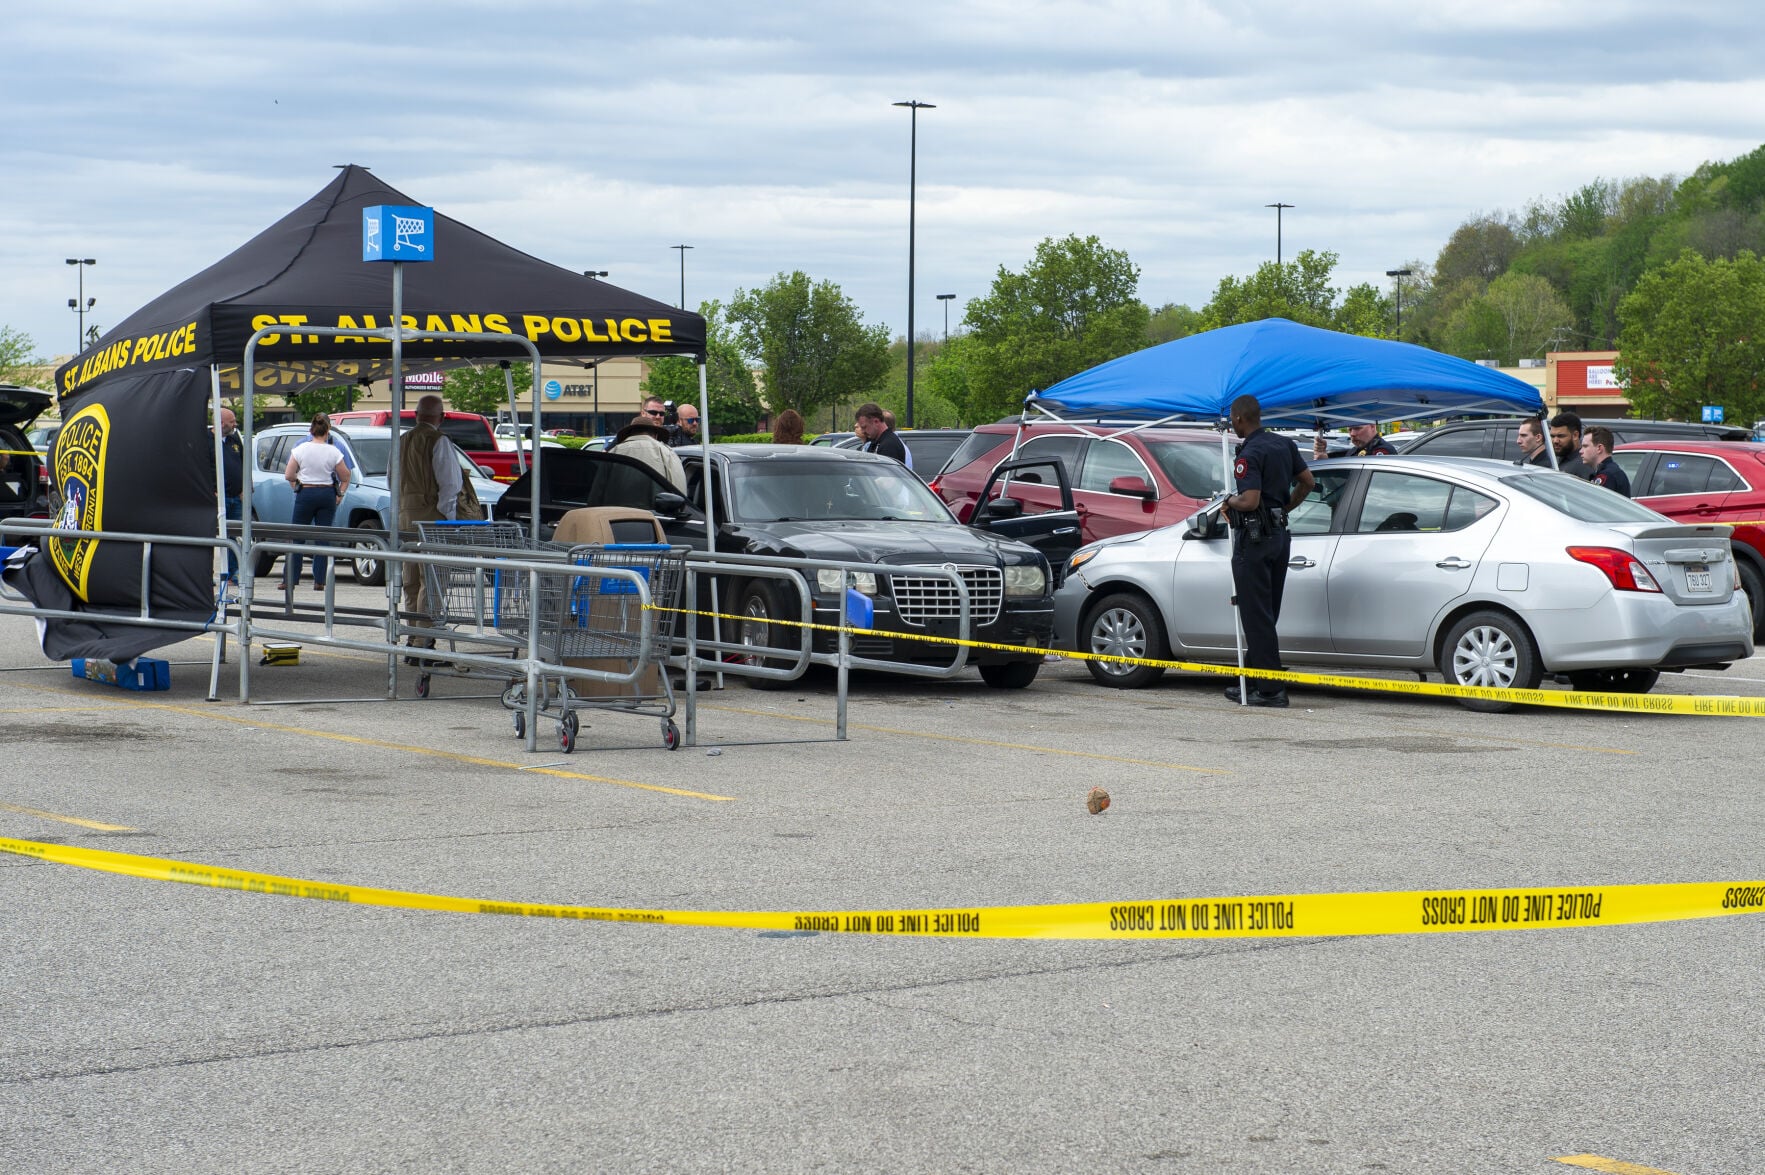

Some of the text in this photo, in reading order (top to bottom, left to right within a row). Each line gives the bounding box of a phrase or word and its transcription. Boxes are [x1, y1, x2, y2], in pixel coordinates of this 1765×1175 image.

[251, 313, 319, 346] ST.
[521, 314, 675, 343] POLICE
[77, 338, 132, 388] ALBANS
[130, 321, 198, 366] POLICE
[563, 384, 594, 397] AT&T
[60, 422, 102, 457] POLICE
[74, 453, 94, 481] 1894
[794, 912, 980, 933] POLICE LINE DO NOT CROSS
[1109, 901, 1294, 931] POLICE LINE DO NOT CROSS
[1422, 892, 1603, 925] POLICE LINE DO NOT CROSS
